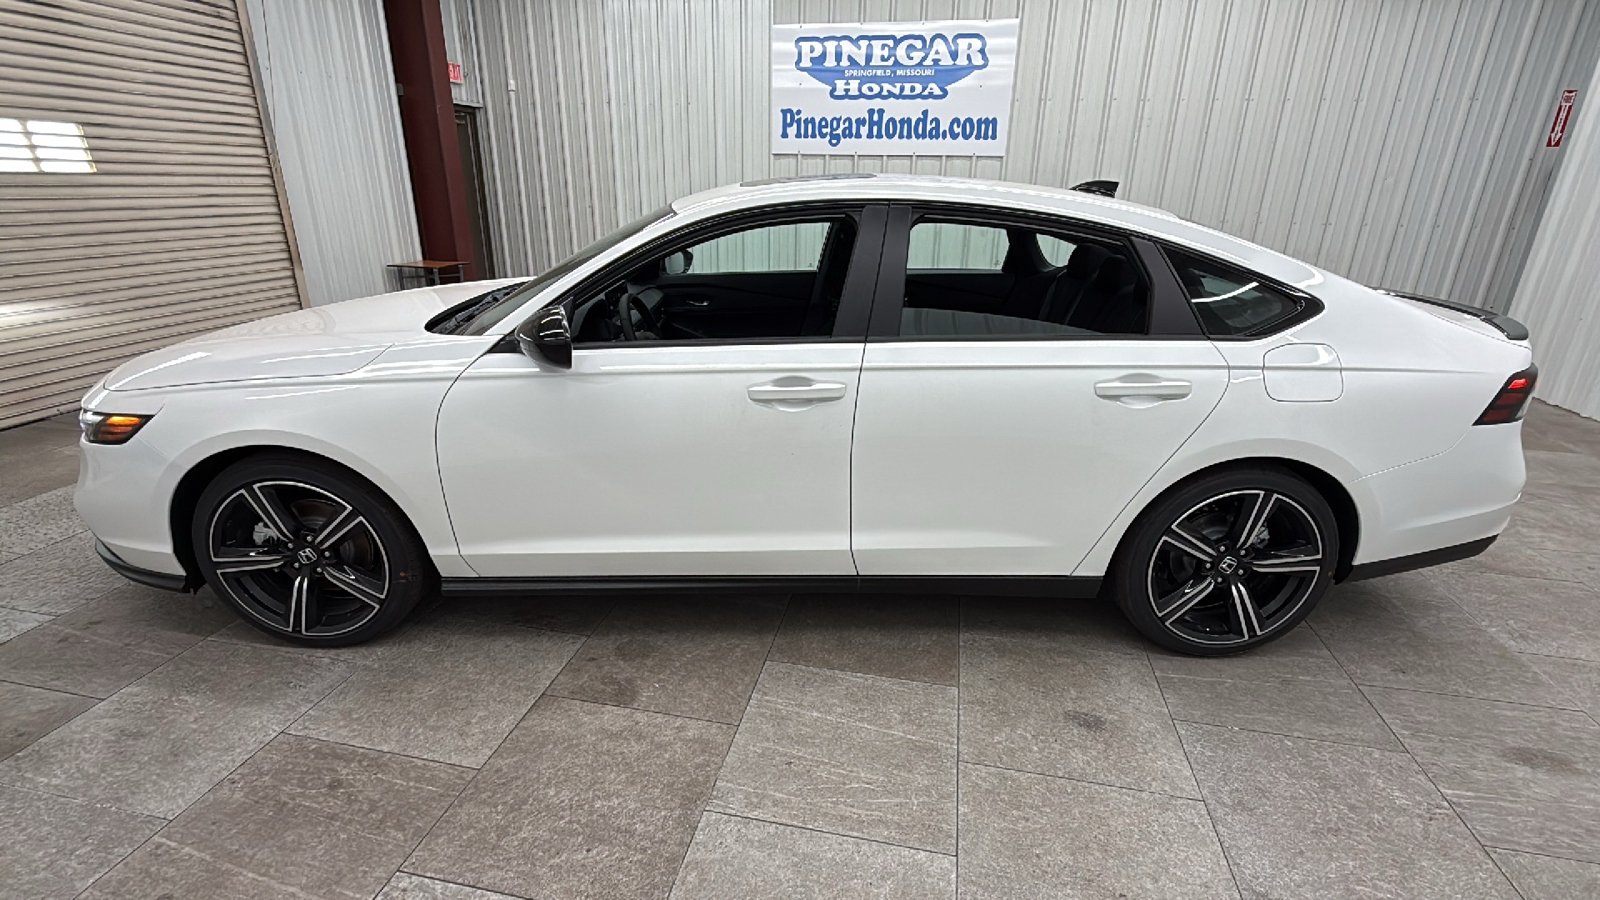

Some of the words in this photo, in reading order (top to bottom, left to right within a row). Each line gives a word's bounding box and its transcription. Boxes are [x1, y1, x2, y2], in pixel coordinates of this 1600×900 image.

[798, 37, 985, 67] PINEGAR
[844, 69, 894, 77] SPRINGFIELD,
[780, 108, 998, 147] PinegarHonda.com
